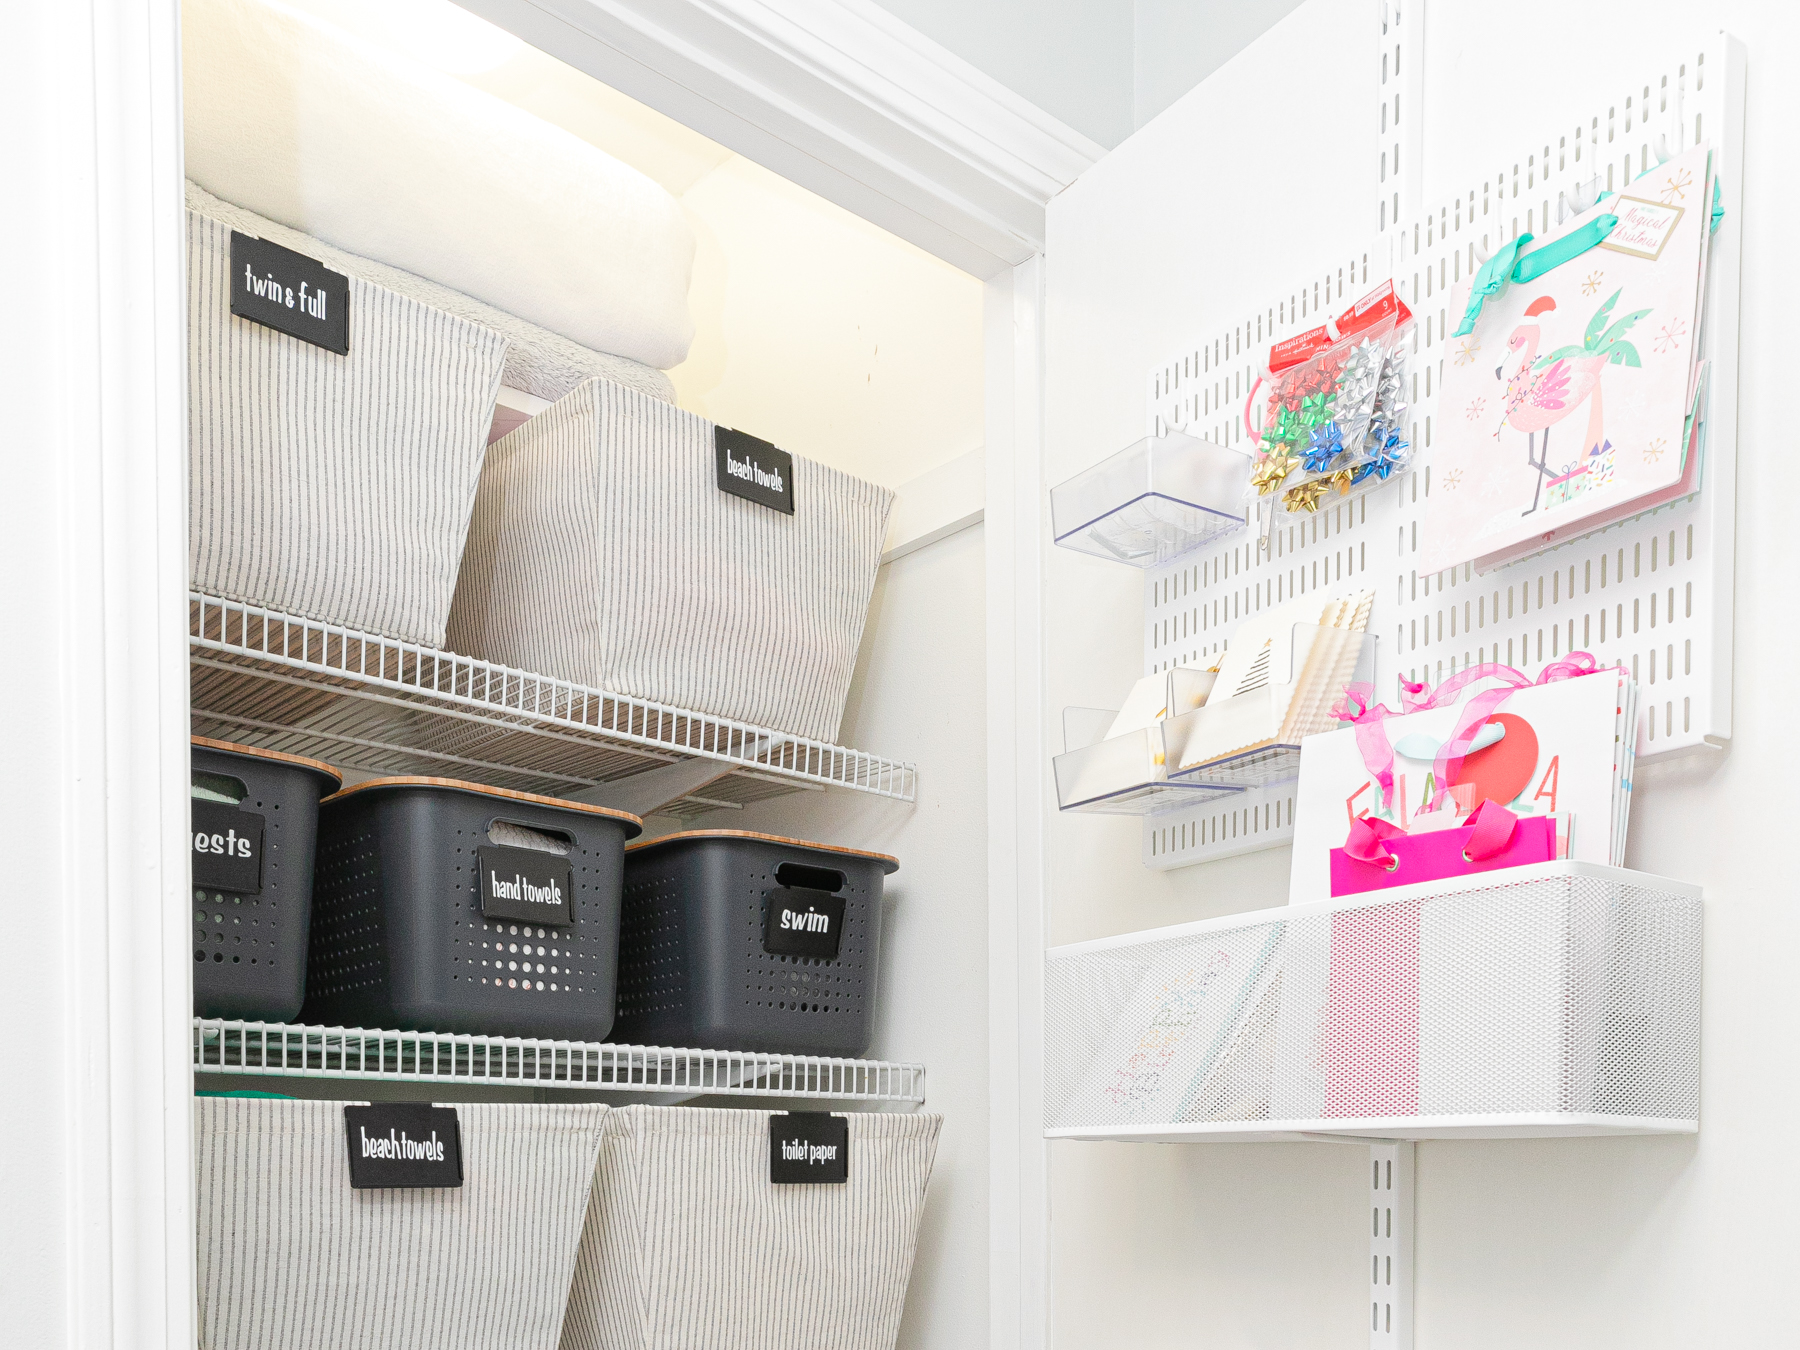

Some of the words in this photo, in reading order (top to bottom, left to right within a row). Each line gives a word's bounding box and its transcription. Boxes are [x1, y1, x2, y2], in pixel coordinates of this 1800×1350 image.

[1620, 206, 1671, 230] Magical
[1610, 223, 1659, 248] Christmas
[245, 263, 283, 304] twin
[285, 287, 295, 309] &
[298, 281, 327, 321] full
[1275, 327, 1323, 353] Inspirations
[727, 449, 753, 482] beach
[754, 461, 783, 493] towels
[192, 829, 252, 858] ests
[491, 870, 521, 901] hand
[522, 877, 562, 905] towels
[780, 906, 829, 933] swim
[360, 1126, 401, 1160] beach
[401, 1131, 445, 1162] towels
[782, 1138, 808, 1160] toilet
[809, 1145, 837, 1166] paper
